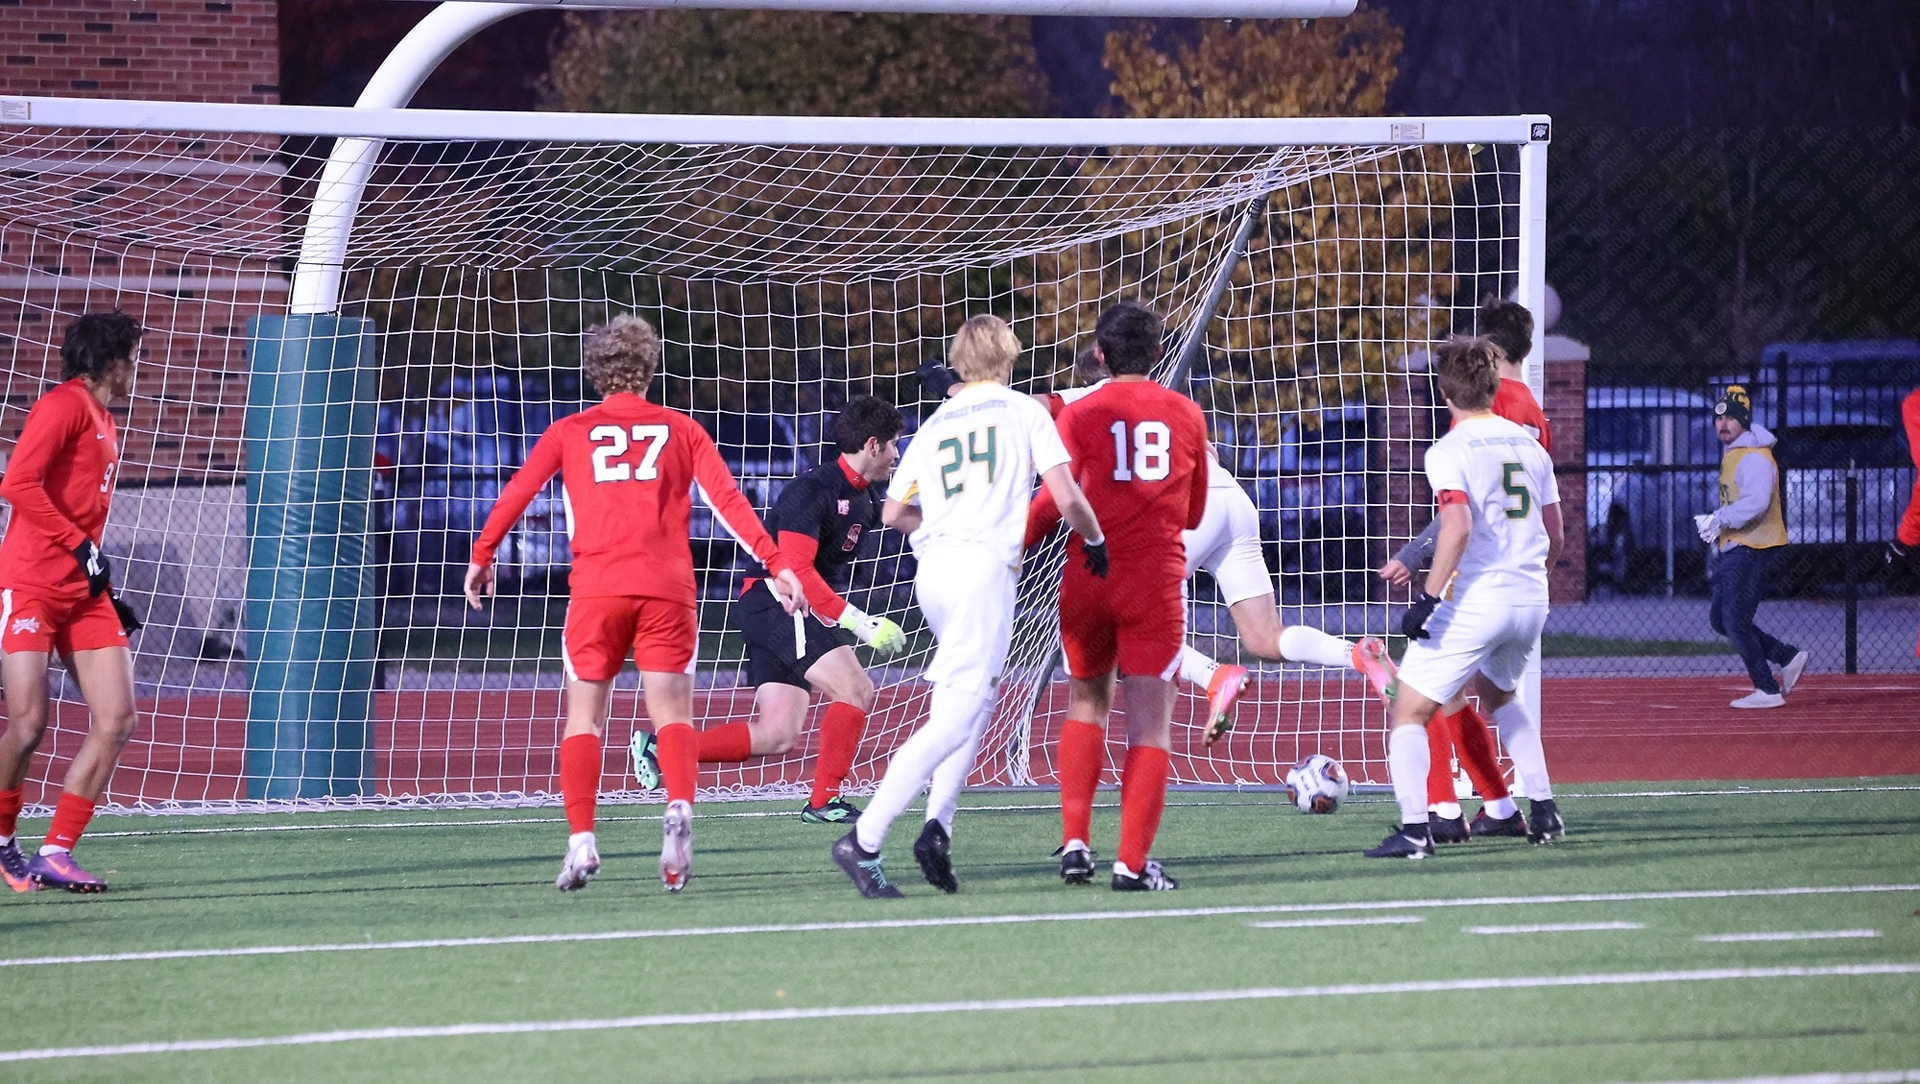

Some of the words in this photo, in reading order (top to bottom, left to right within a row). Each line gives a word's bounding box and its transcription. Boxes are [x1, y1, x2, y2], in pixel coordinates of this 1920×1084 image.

[100, 462, 115, 493] 9
[588, 424, 671, 483] 27
[937, 425, 998, 501] 24
[1109, 419, 1172, 481] 18
[1501, 461, 1531, 520] 5
